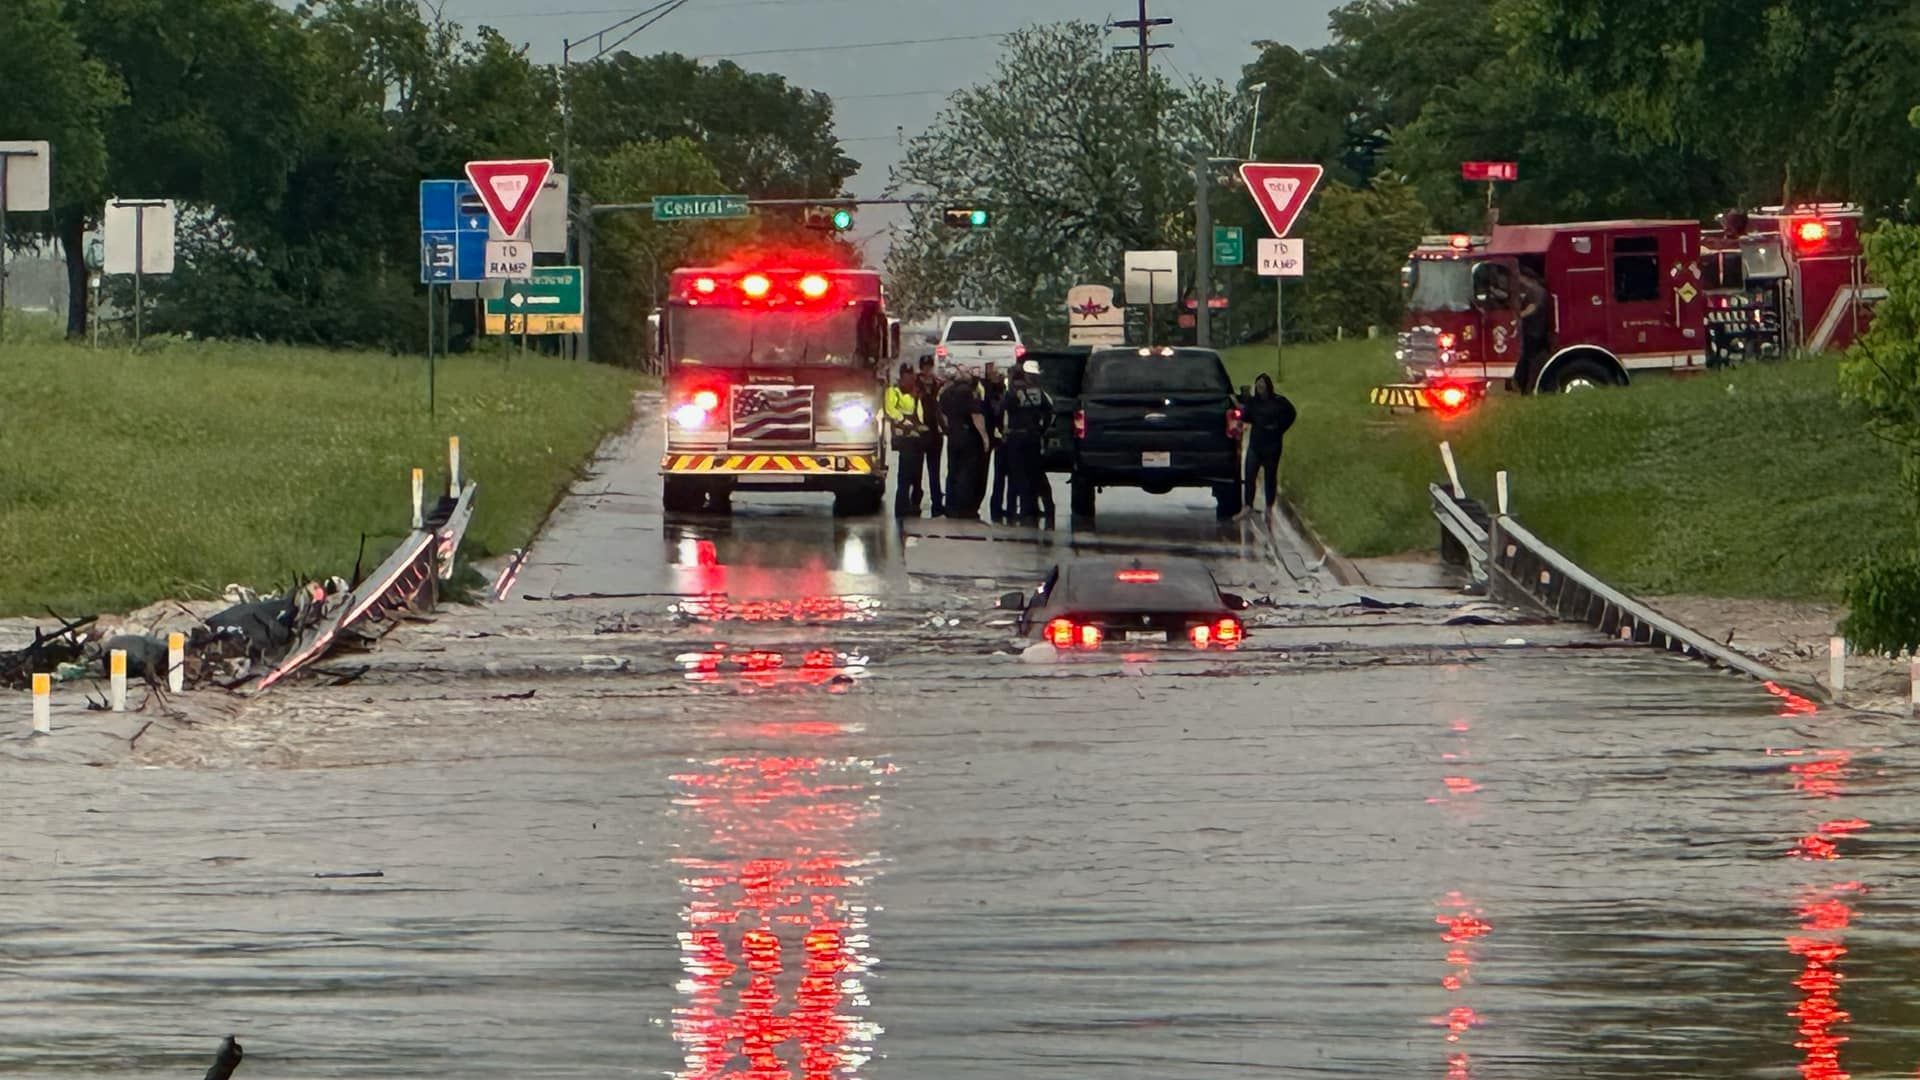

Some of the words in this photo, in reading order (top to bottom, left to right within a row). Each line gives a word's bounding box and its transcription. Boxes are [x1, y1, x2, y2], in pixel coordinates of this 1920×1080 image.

[663, 199, 722, 215] Central
[501, 246, 518, 257] TO
[1273, 242, 1289, 255] TO
[489, 262, 527, 273] RAMP
[1263, 259, 1298, 269] RAMP
